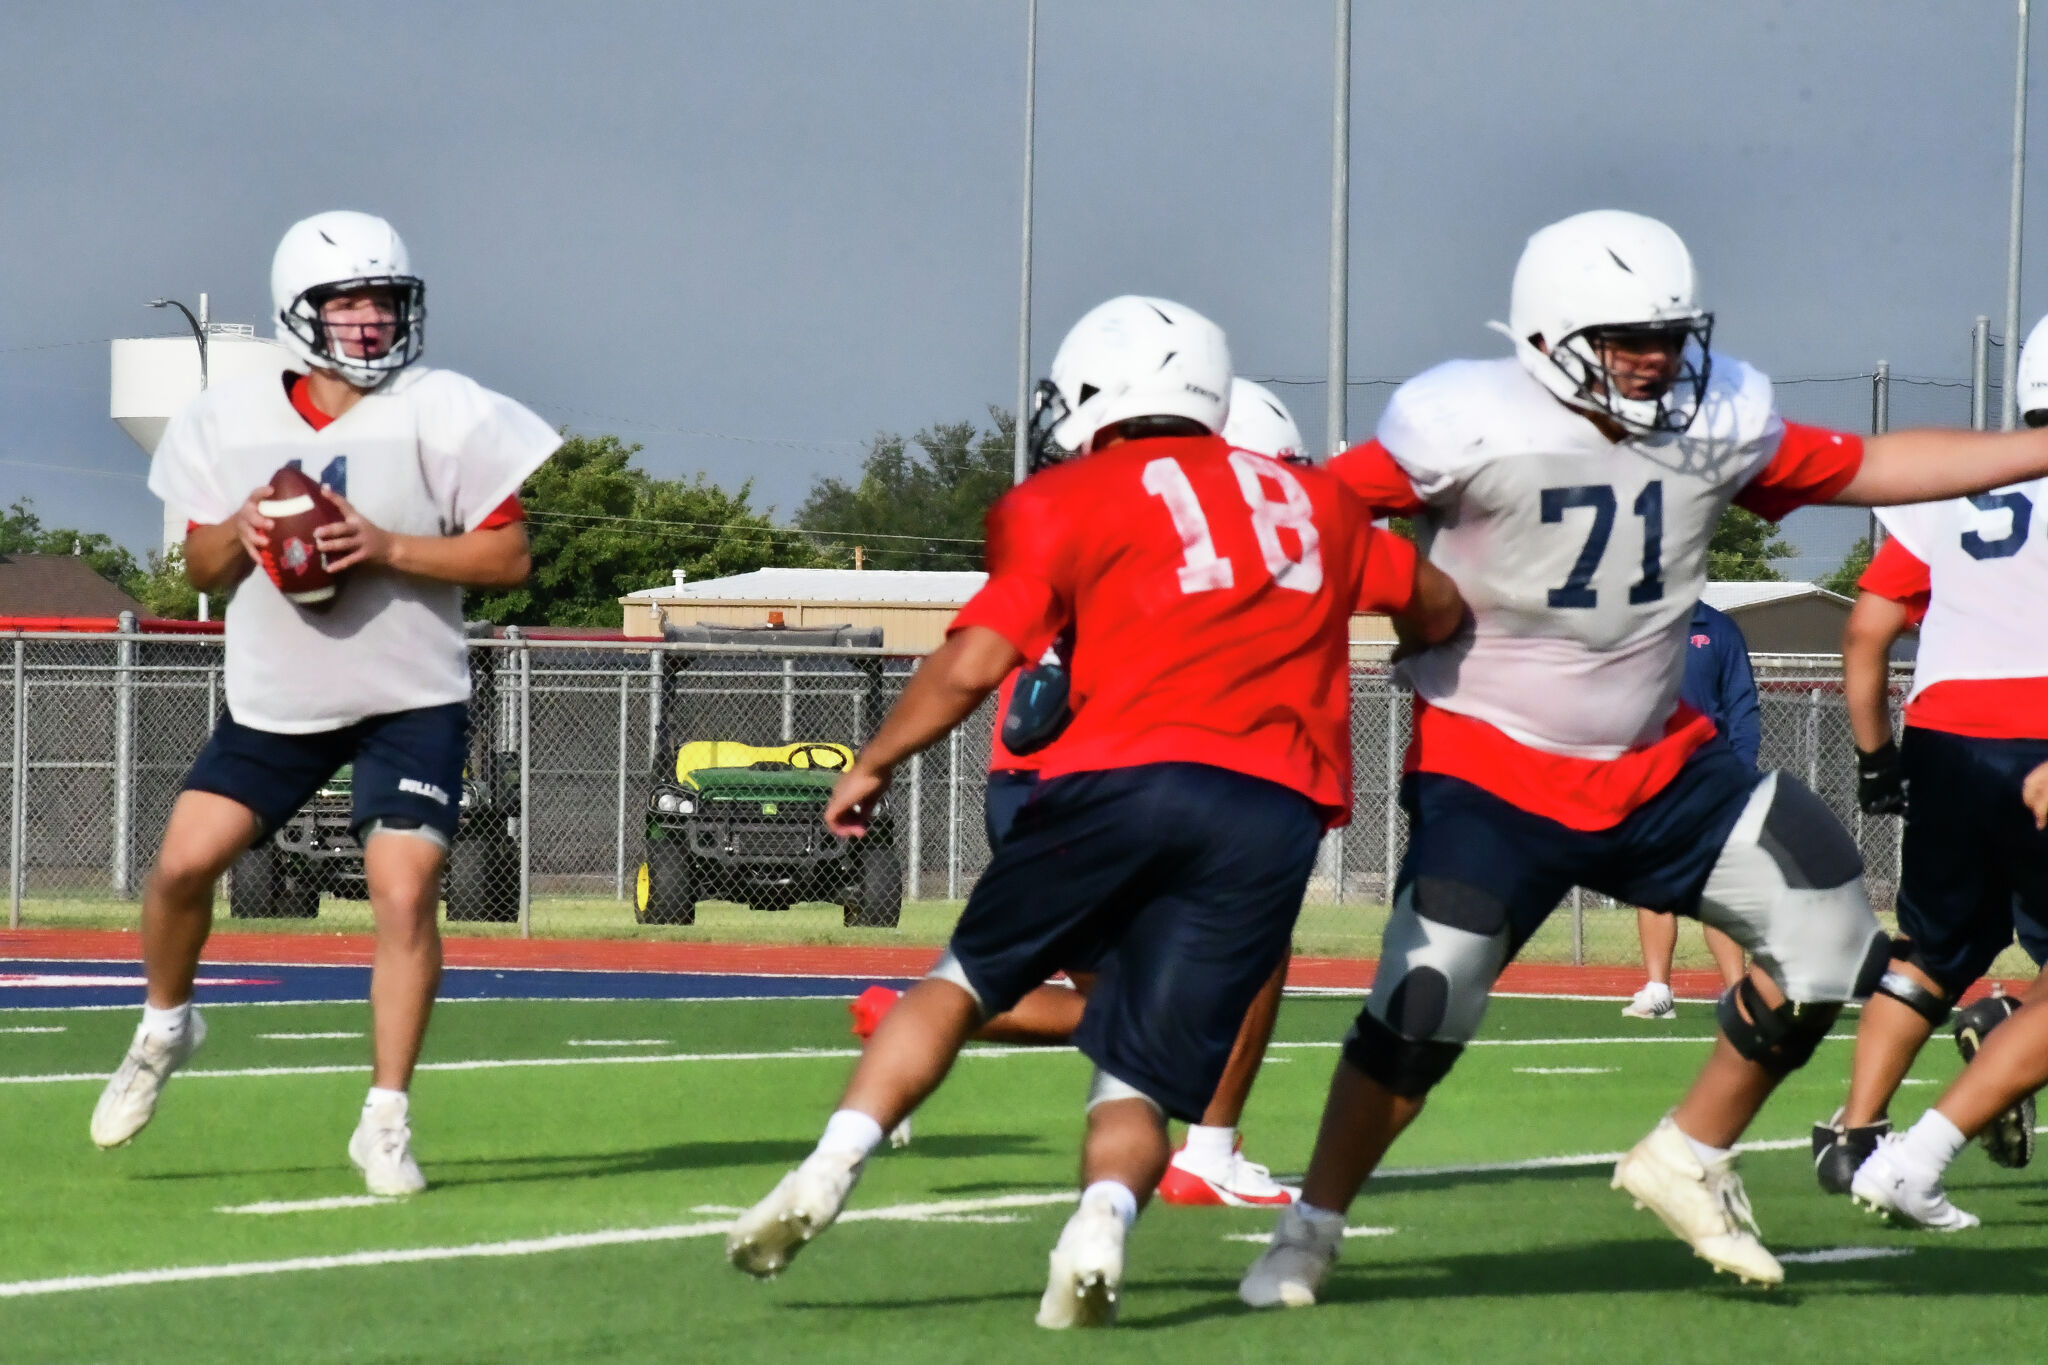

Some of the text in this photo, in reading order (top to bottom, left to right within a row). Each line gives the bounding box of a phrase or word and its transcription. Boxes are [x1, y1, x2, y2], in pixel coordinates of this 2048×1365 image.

[1141, 450, 1323, 594] 18
[1540, 479, 1665, 609] 71
[1960, 490, 2048, 561] 5
